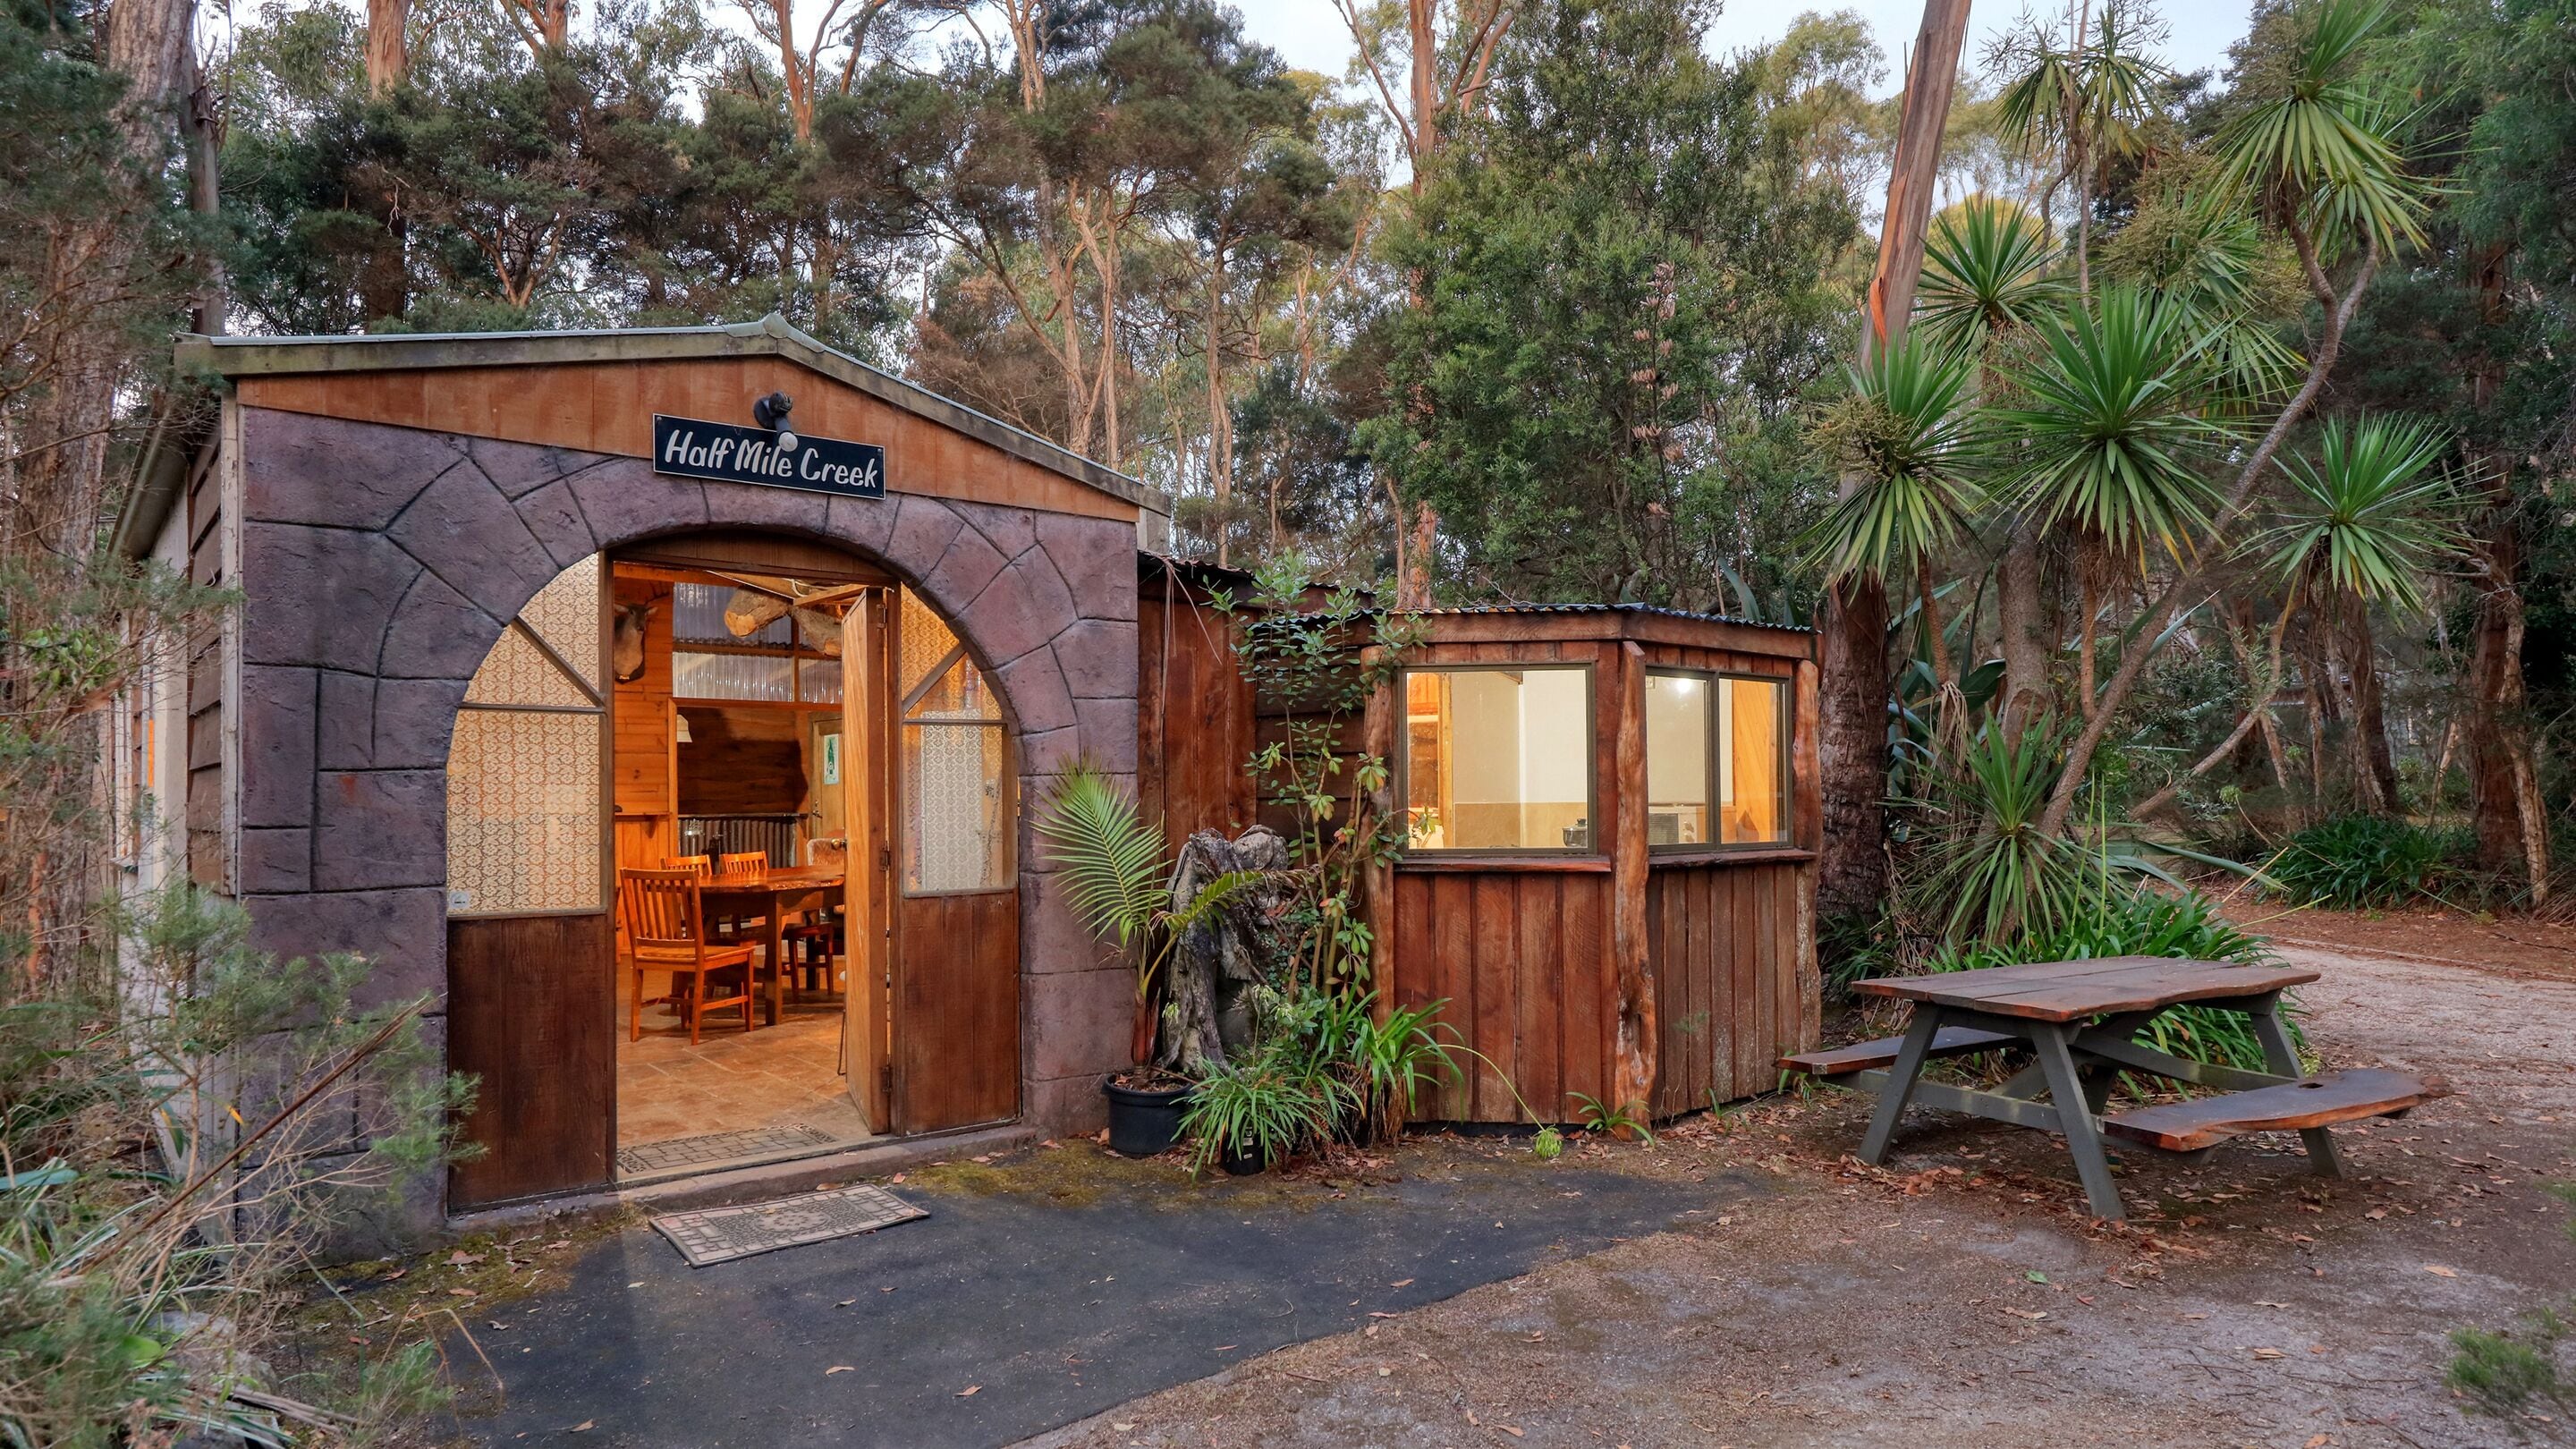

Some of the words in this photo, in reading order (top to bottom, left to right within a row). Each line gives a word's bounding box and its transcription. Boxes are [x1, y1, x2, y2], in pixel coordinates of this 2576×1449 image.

[665, 429, 734, 469] Half
[734, 438, 792, 477] Mile
[801, 448, 877, 487] Creek
